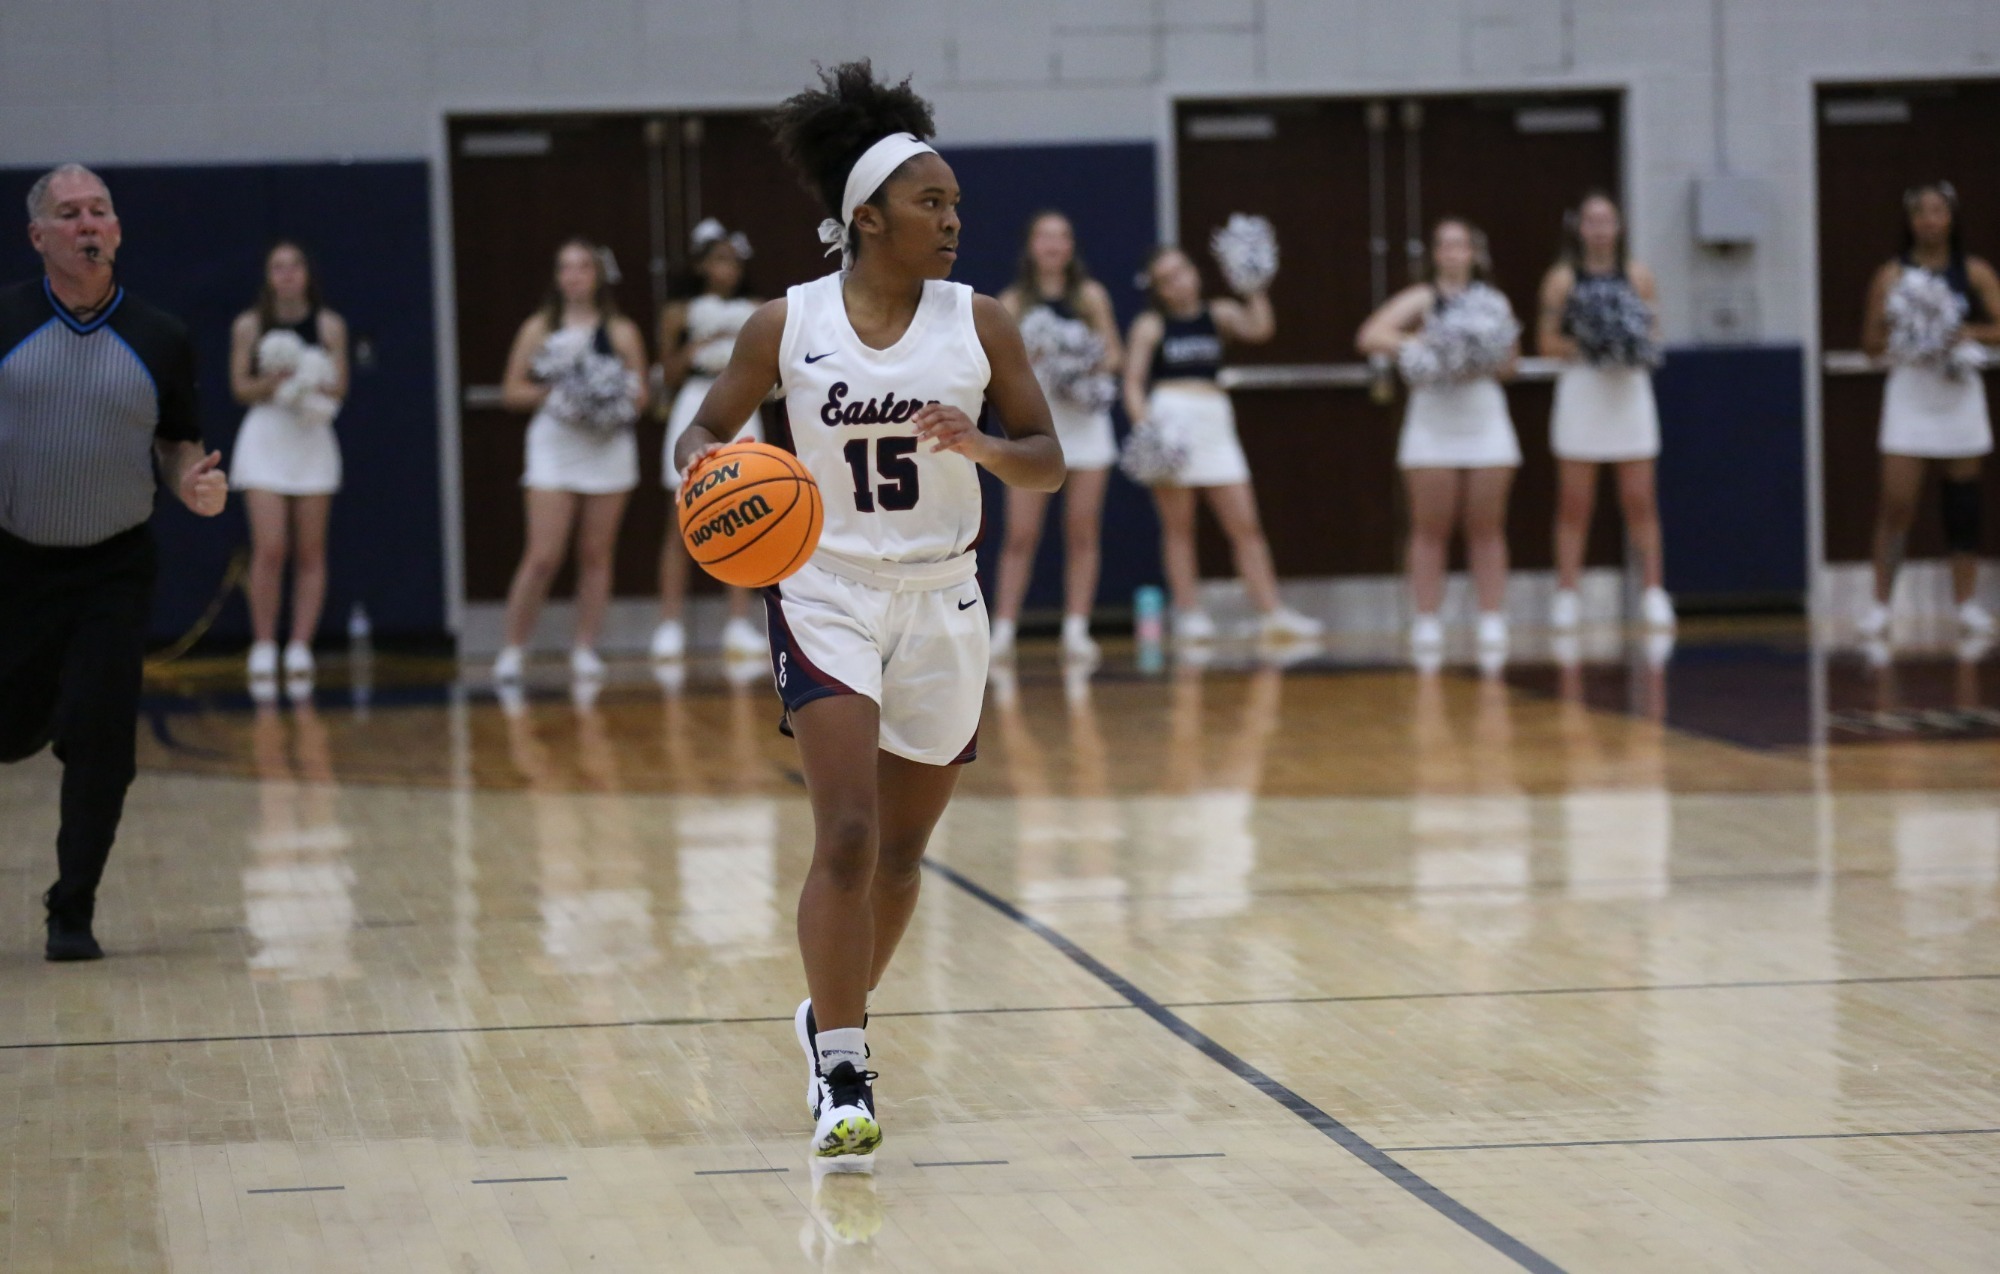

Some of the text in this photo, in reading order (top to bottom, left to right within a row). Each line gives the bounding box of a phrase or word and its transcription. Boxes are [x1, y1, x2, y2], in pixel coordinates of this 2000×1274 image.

[820, 381, 941, 427] Easter
[684, 462, 741, 510] NCAA
[843, 436, 920, 513] 15
[689, 494, 774, 548] Wilson
